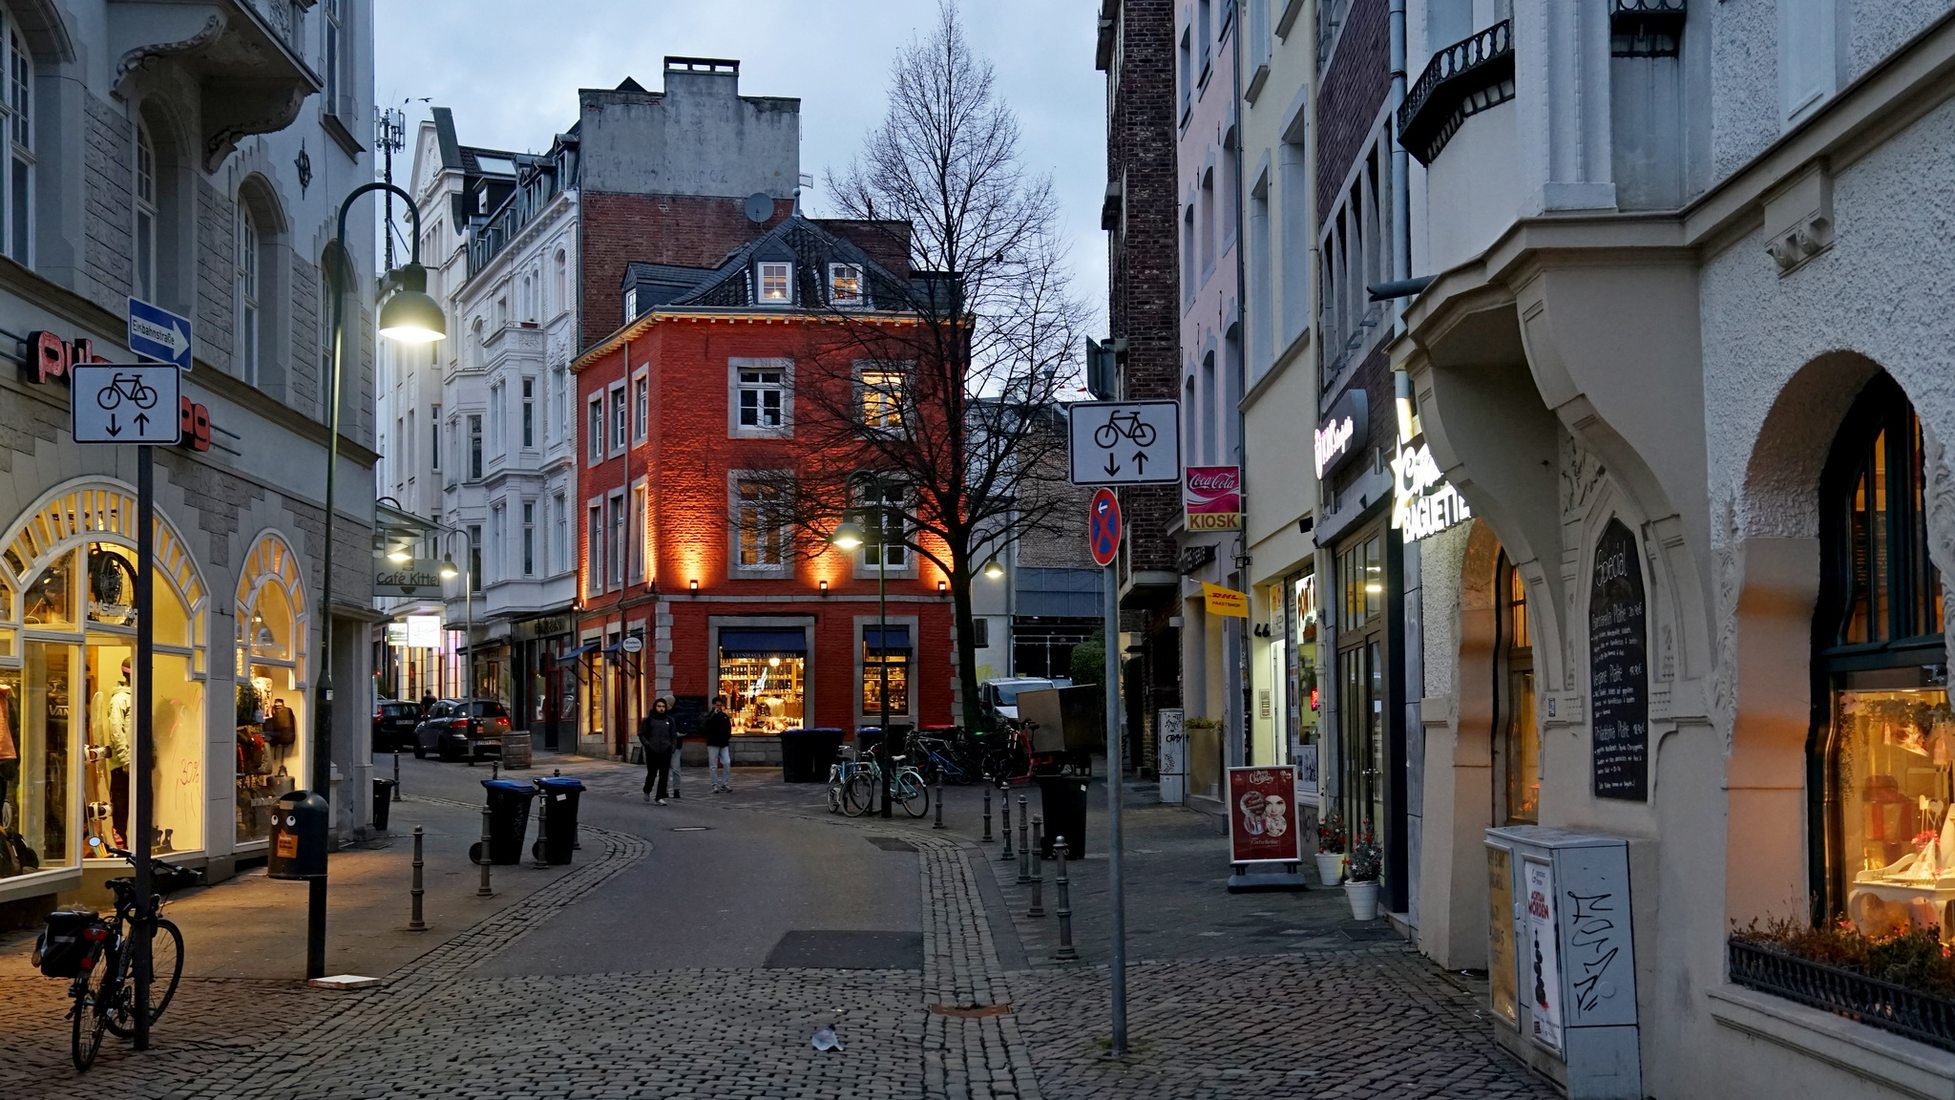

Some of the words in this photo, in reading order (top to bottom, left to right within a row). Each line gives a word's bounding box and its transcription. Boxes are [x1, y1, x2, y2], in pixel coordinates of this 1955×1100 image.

[1189, 473, 1236, 490] Coca-Cola
[1189, 514, 1238, 529] KIOSK
[1595, 540, 1628, 597] Special
[376, 572, 406, 584] Café
[410, 572, 440, 586] Kittel
[1211, 592, 1240, 600] DHL
[1254, 623, 1270, 638] 46
